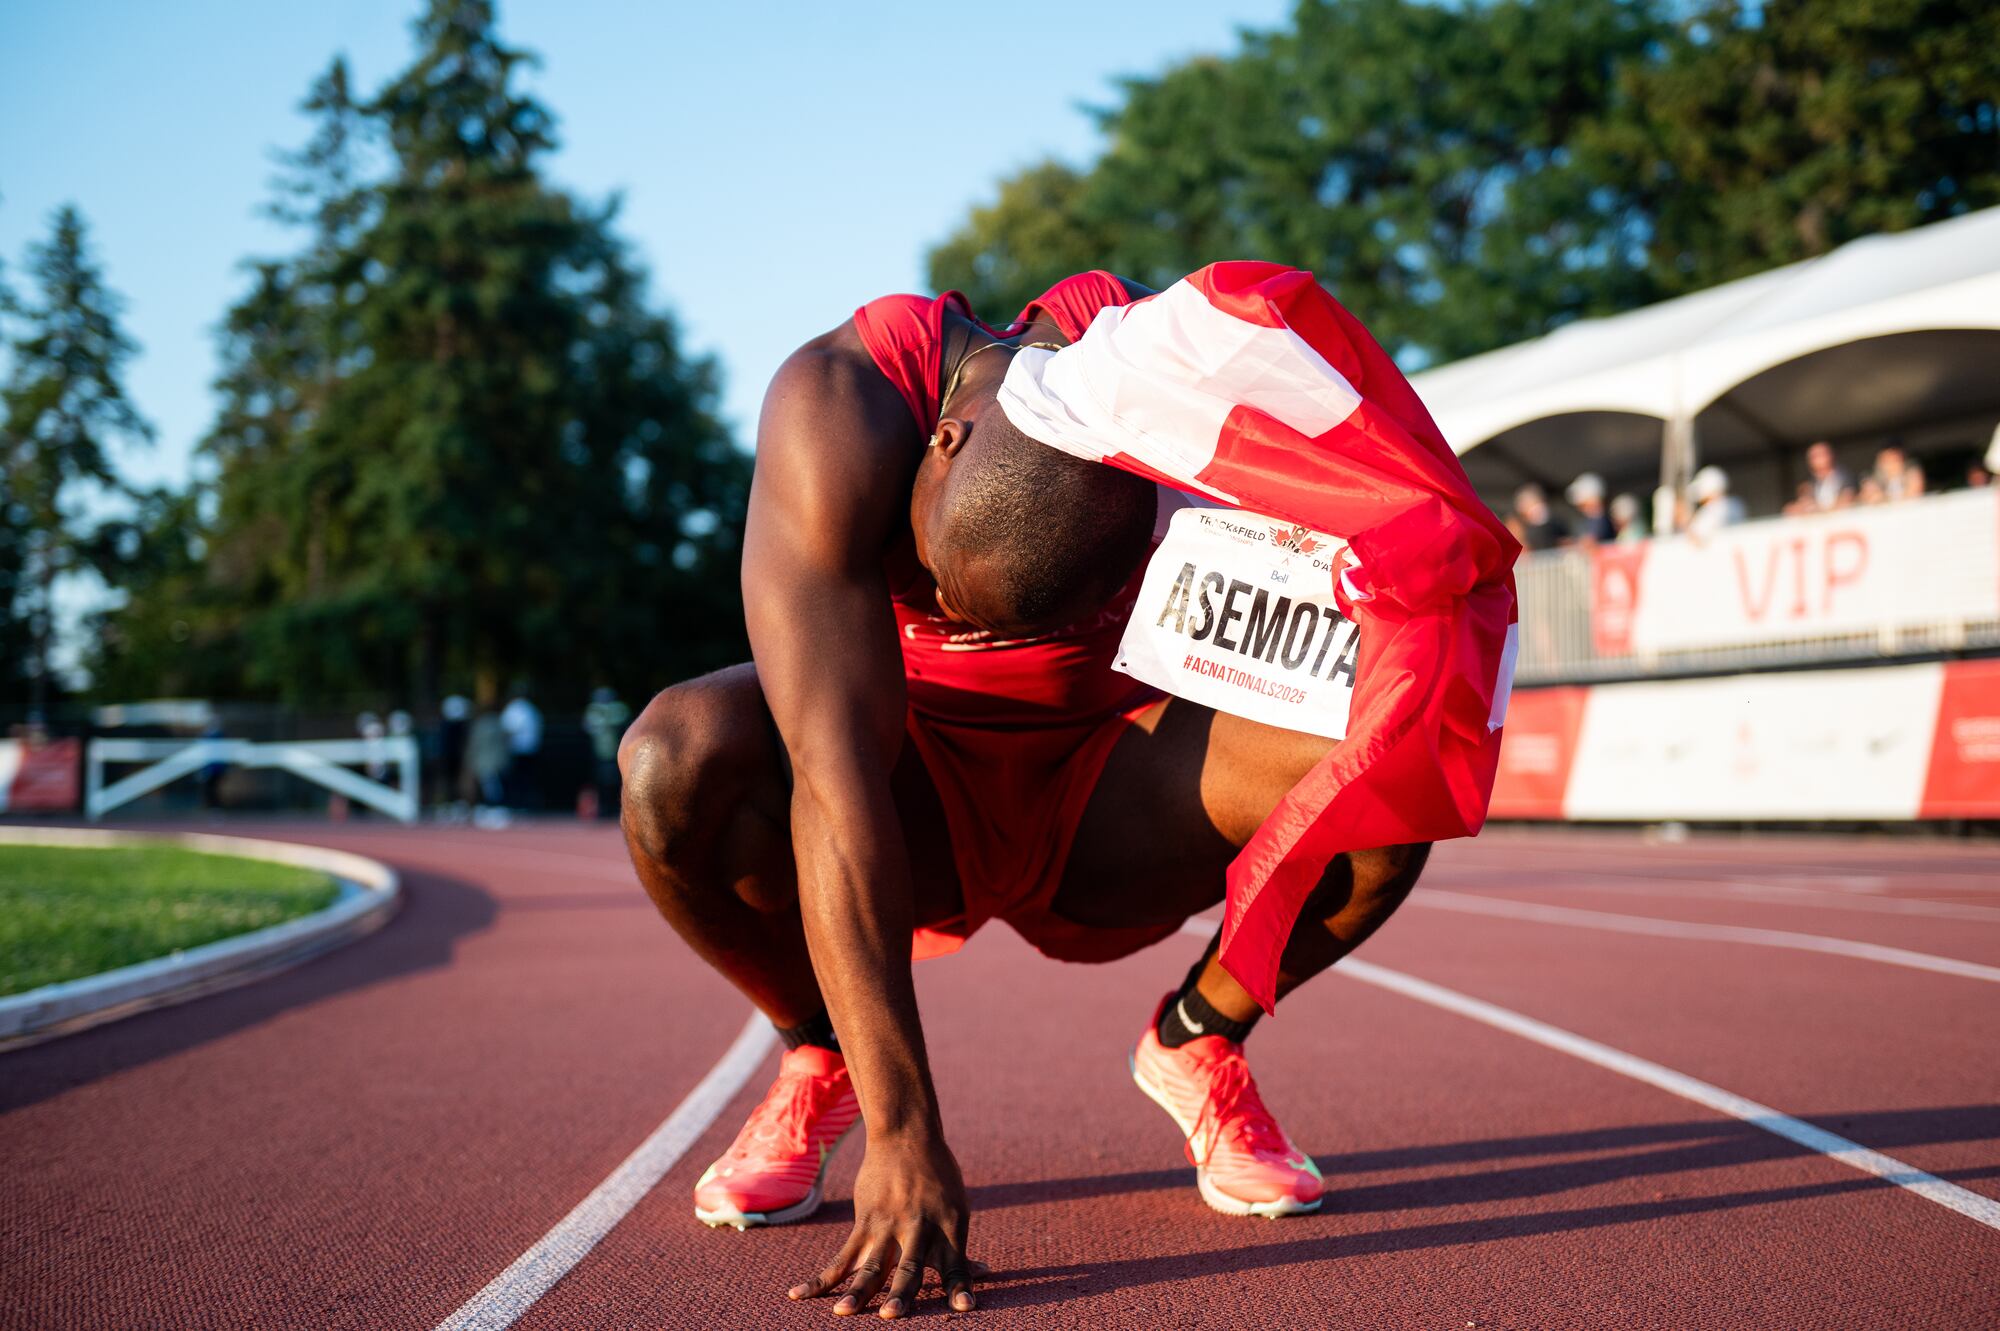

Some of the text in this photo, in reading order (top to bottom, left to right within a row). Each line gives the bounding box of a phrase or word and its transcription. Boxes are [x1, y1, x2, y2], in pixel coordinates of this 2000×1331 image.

[1270, 570, 1289, 584] Bell
[1732, 529, 1869, 622] VIP
[1156, 562, 1361, 688] ASEMOTA
[1183, 654, 1307, 704] #ACNATIONALS2025
